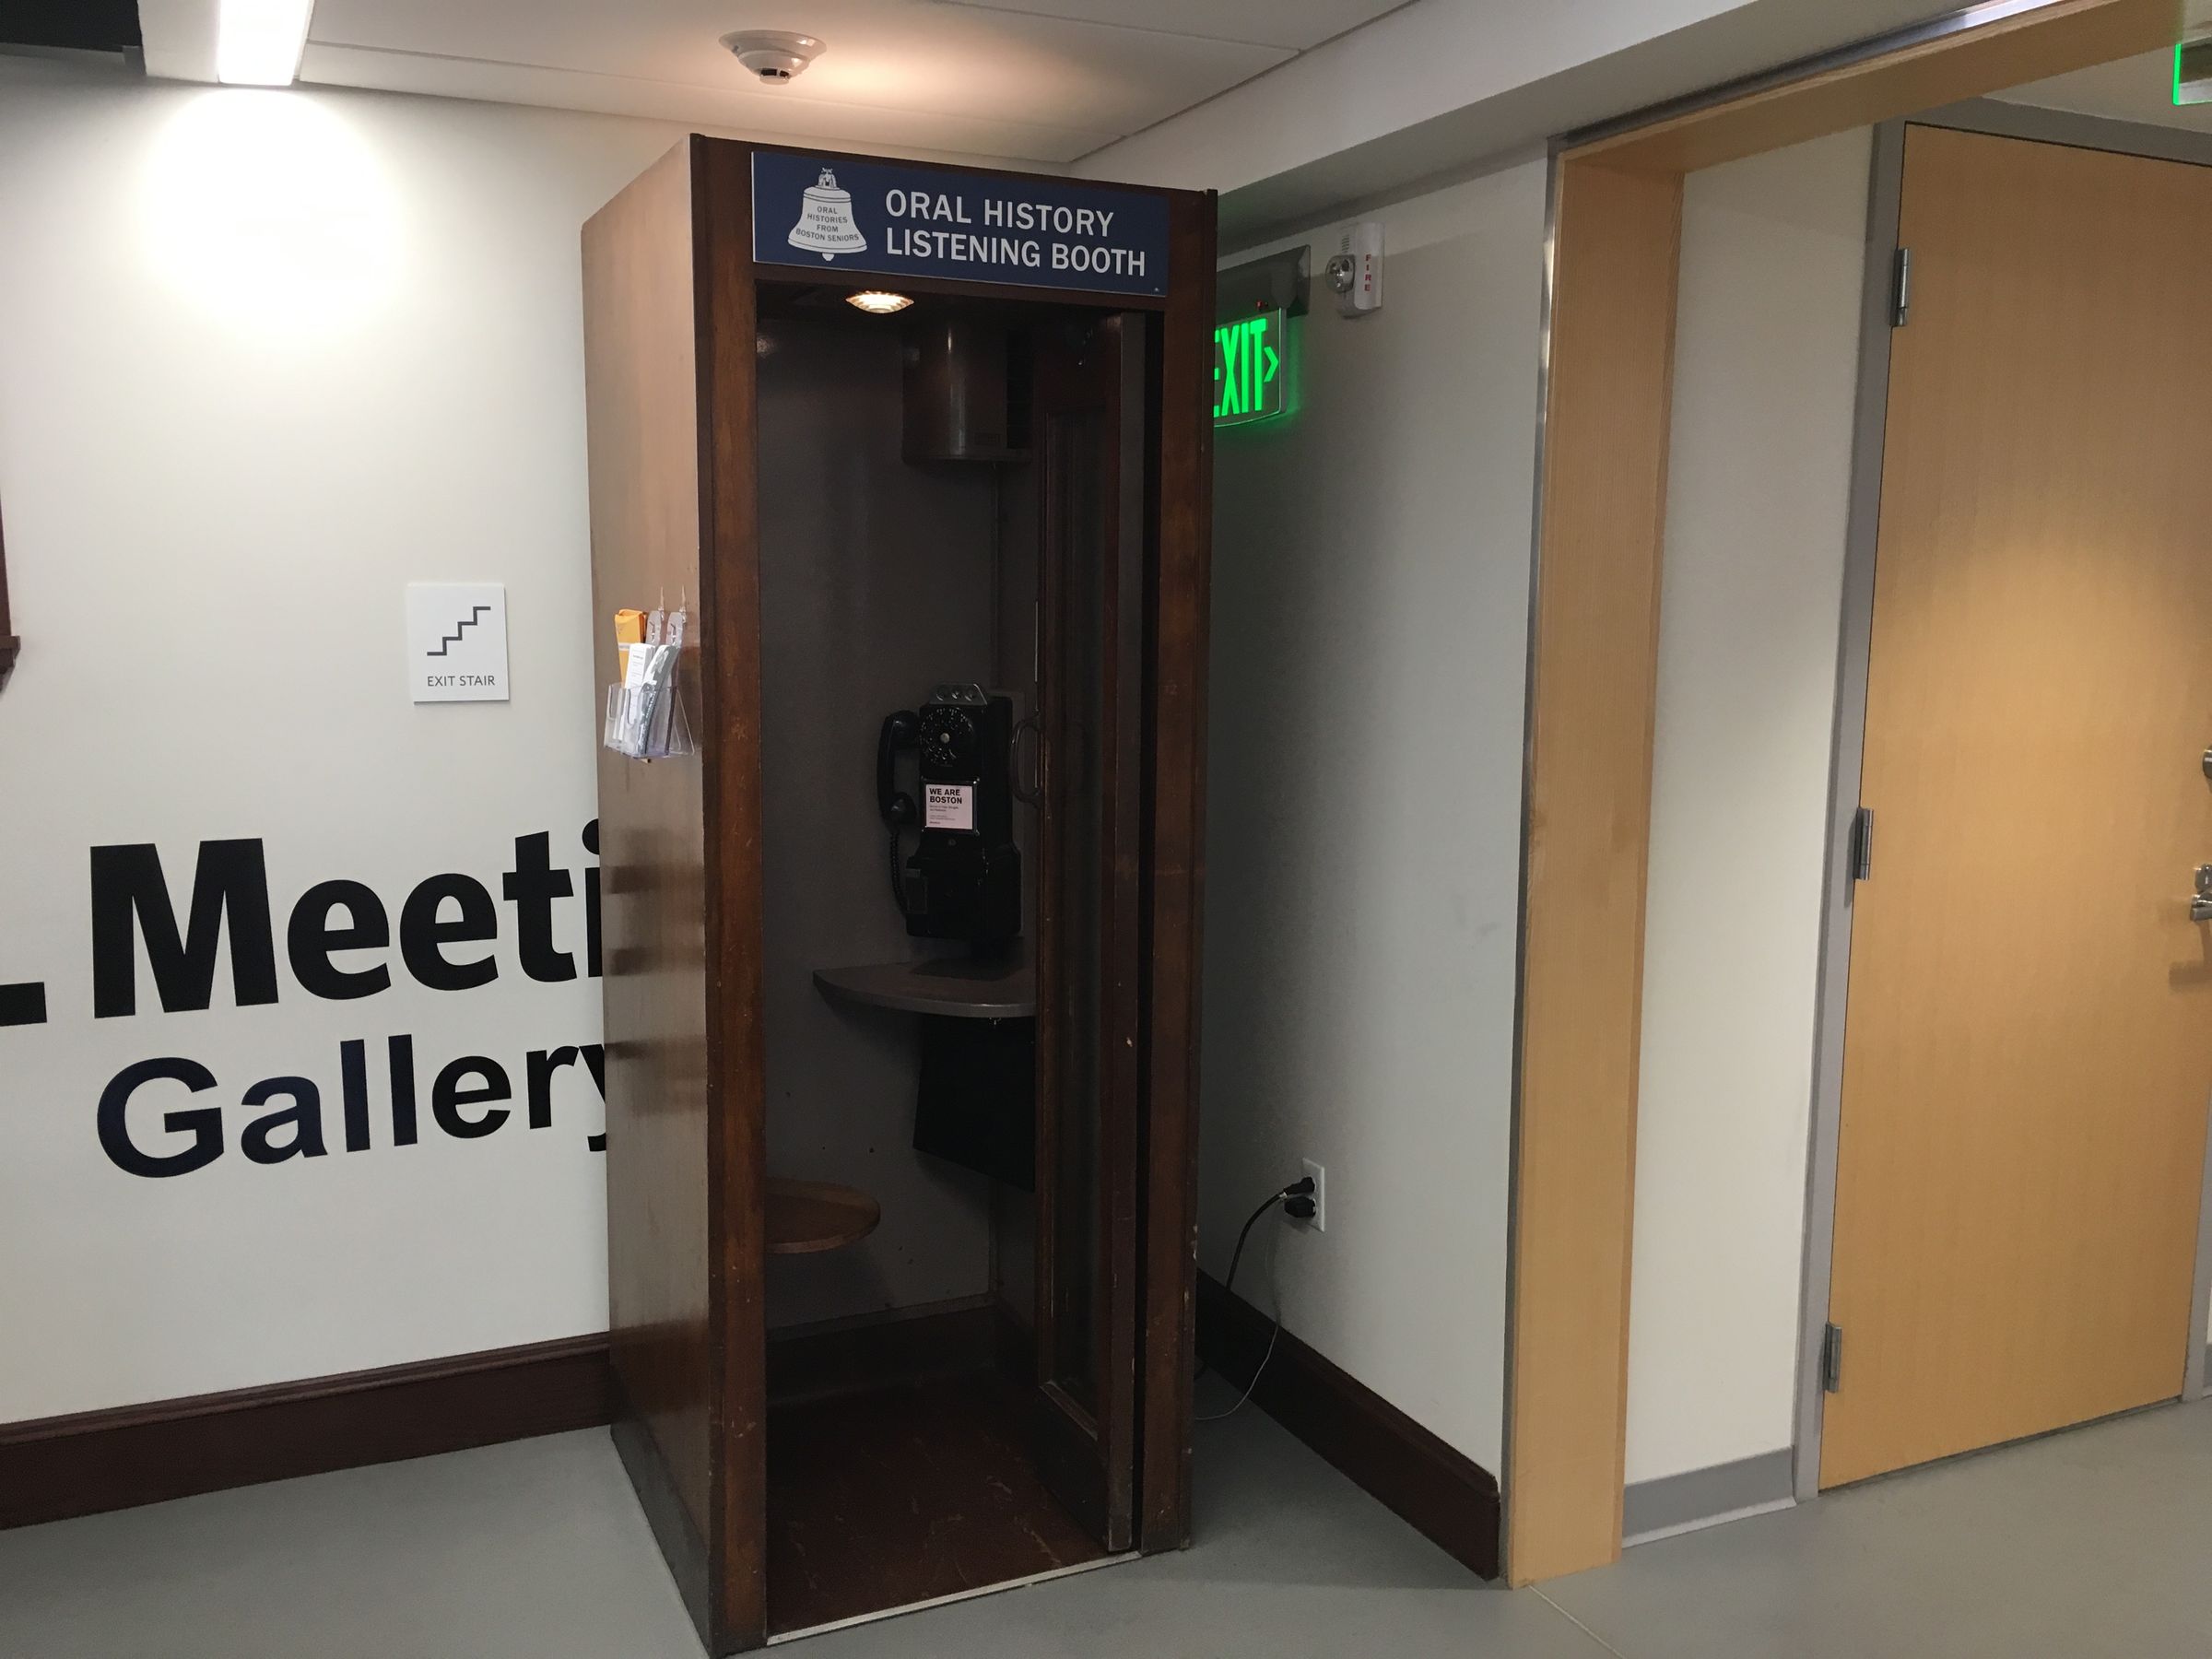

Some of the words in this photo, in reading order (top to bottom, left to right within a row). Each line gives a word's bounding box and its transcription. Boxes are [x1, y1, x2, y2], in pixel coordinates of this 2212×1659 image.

[817, 206, 838, 214] ORAL
[886, 189, 971, 224] ORAL
[984, 199, 1113, 237] HISTORY
[807, 214, 848, 223] HISTORIES
[795, 228, 826, 241] BOSTON
[828, 234, 859, 242] SENIORS
[817, 224, 839, 232] FROM
[887, 227, 1041, 267] LISTENING
[1052, 242, 1145, 276] BOOTH
[1364, 253, 1372, 291] FIRE
[1214, 318, 1267, 418] XIT
[427, 676, 455, 687] EXIT
[459, 675, 496, 687] STAIR
